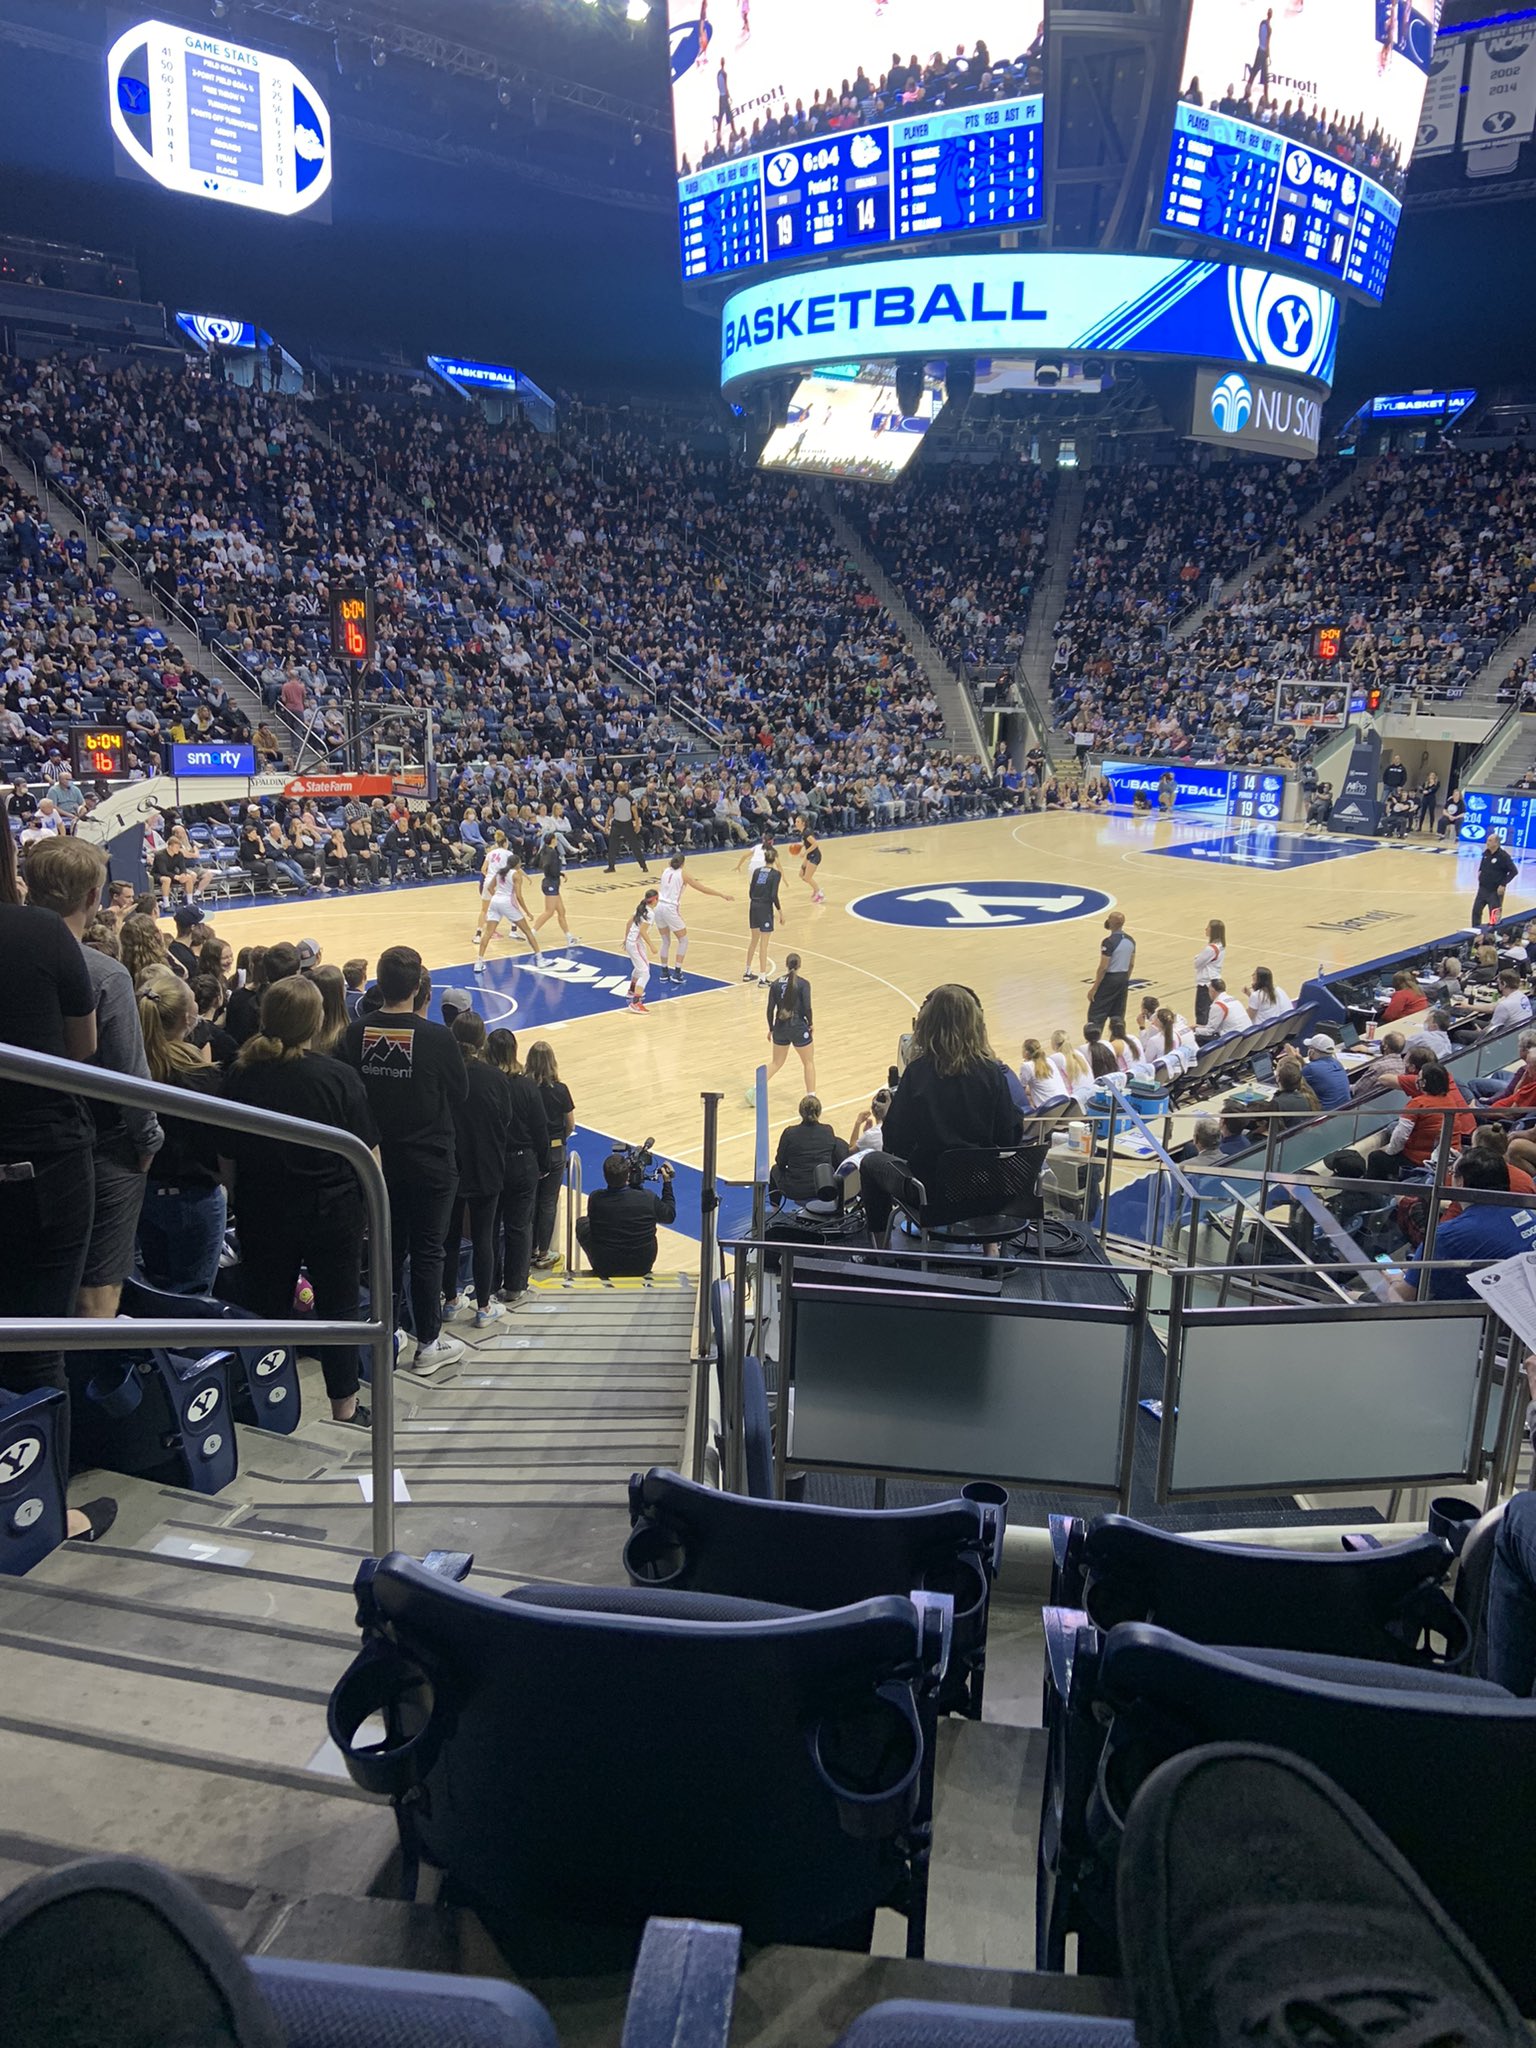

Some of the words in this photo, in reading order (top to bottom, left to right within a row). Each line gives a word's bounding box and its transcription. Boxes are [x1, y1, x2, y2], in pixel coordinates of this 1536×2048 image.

[185, 36, 220, 55] GAME
[224, 47, 258, 67] STATS
[161, 60, 173, 71] 50
[1490, 66, 1520, 80] 2002
[161, 73, 174, 84] 60
[1489, 82, 1517, 96] 2014
[904, 124, 929, 139] PLAYER
[965, 114, 979, 129] PTS
[985, 111, 999, 125] REB
[1005, 108, 1019, 122] AST
[1026, 105, 1036, 118] PF
[1187, 114, 1209, 132] PLAYER
[802, 145, 840, 173] 6:04
[832, 174, 838, 192] 2
[856, 197, 875, 231] 14
[776, 214, 793, 246] 19
[1281, 212, 1296, 245] 19
[726, 281, 1047, 356] BASKETBALL
[1276, 300, 1310, 353] Y
[1256, 389, 1293, 432] NU
[1294, 397, 1322, 442] SKIN
[343, 600, 365, 619] 6:04
[348, 622, 363, 653] 16
[1321, 629, 1340, 639] 6:04
[1323, 641, 1336, 656] 16
[1446, 689, 1463, 697] EXIT
[87, 733, 120, 750] 6:04
[95, 752, 112, 771] 16
[187, 750, 241, 769] smarty
[1244, 775, 1255, 790] 14
[1260, 792, 1276, 803] 6:04
[1241, 801, 1253, 816] 19
[1498, 798, 1511, 815] 14
[1464, 812, 1482, 824] 6:04
[1490, 816, 1508, 824] PERIOD
[491, 853, 501, 863] 24
[361, 1063, 413, 1078] element
[210, 1440, 216, 1449] 6
[1, 1443, 30, 1477] Y
[25, 1507, 32, 1518] 7
[188, 1543, 221, 1561] 7
